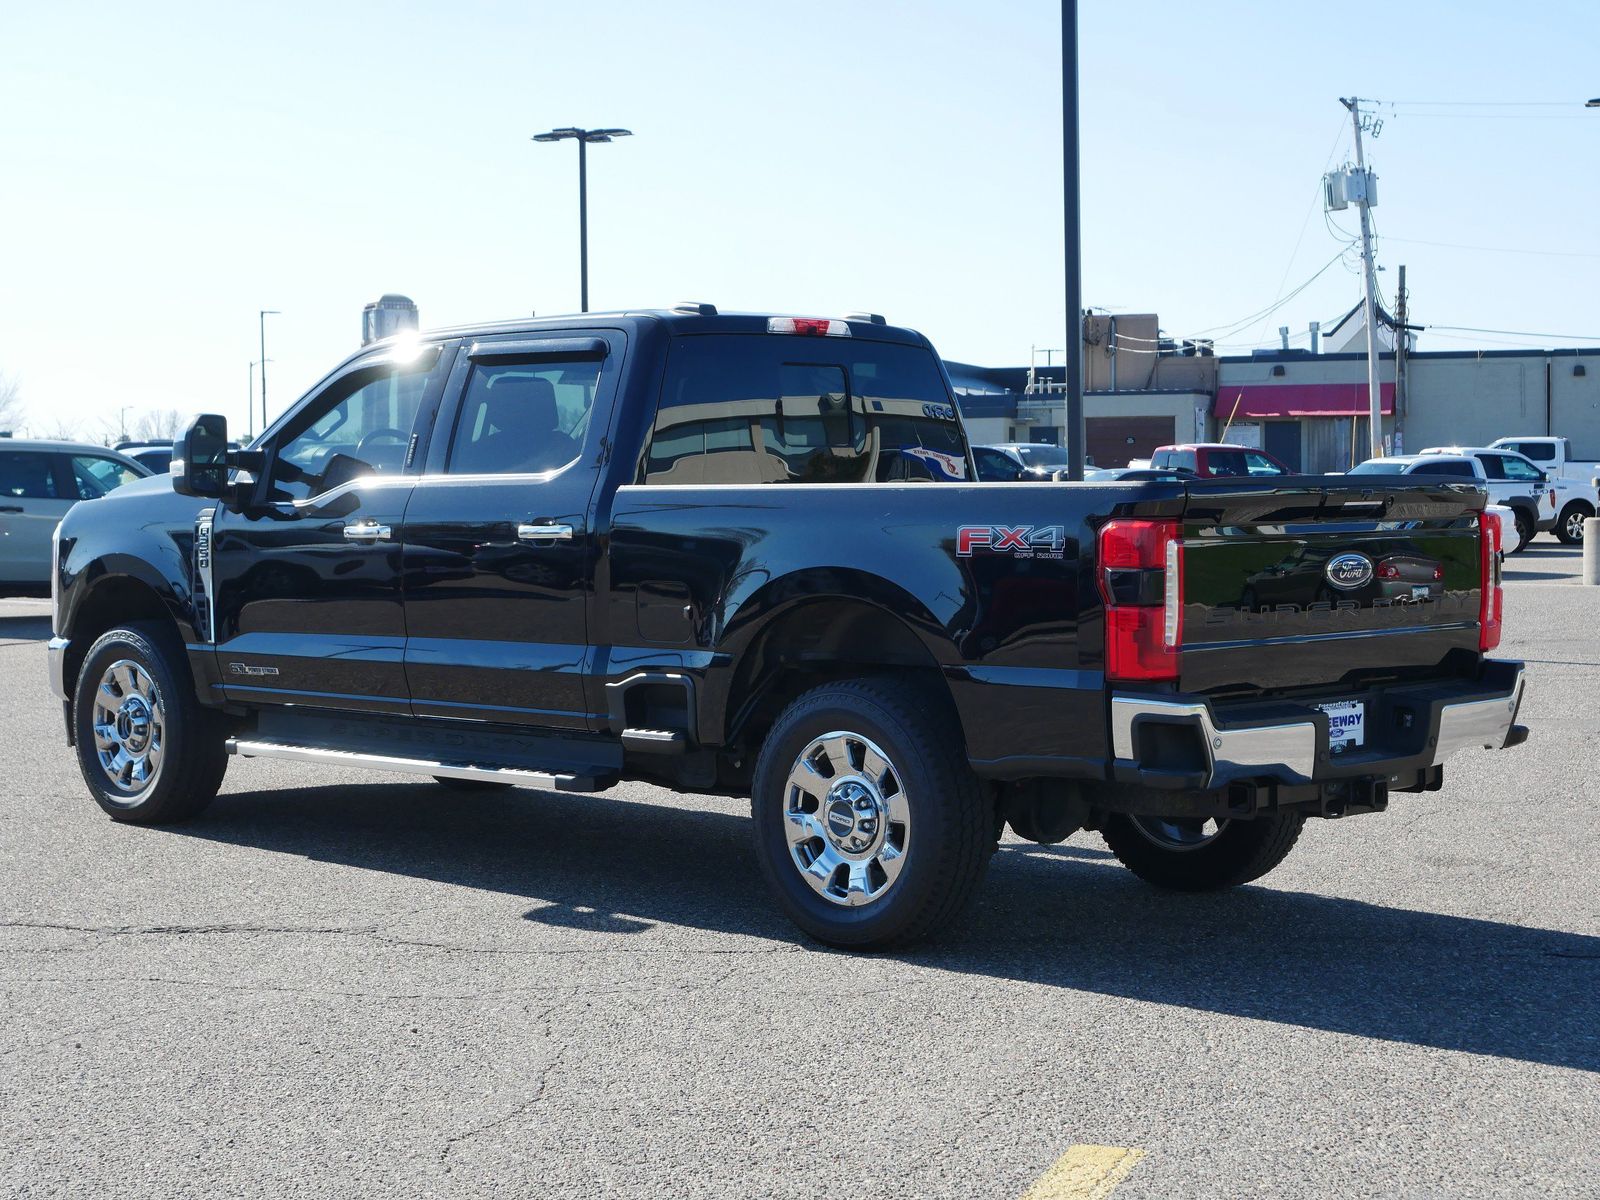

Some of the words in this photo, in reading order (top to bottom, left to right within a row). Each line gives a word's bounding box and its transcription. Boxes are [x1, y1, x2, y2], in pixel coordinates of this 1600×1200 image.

[956, 525, 1065, 557] FX4
[1338, 561, 1364, 579] Ford
[1205, 599, 1361, 627] SUPER
[1373, 592, 1471, 622] DUTY
[831, 814, 850, 824] FORD
